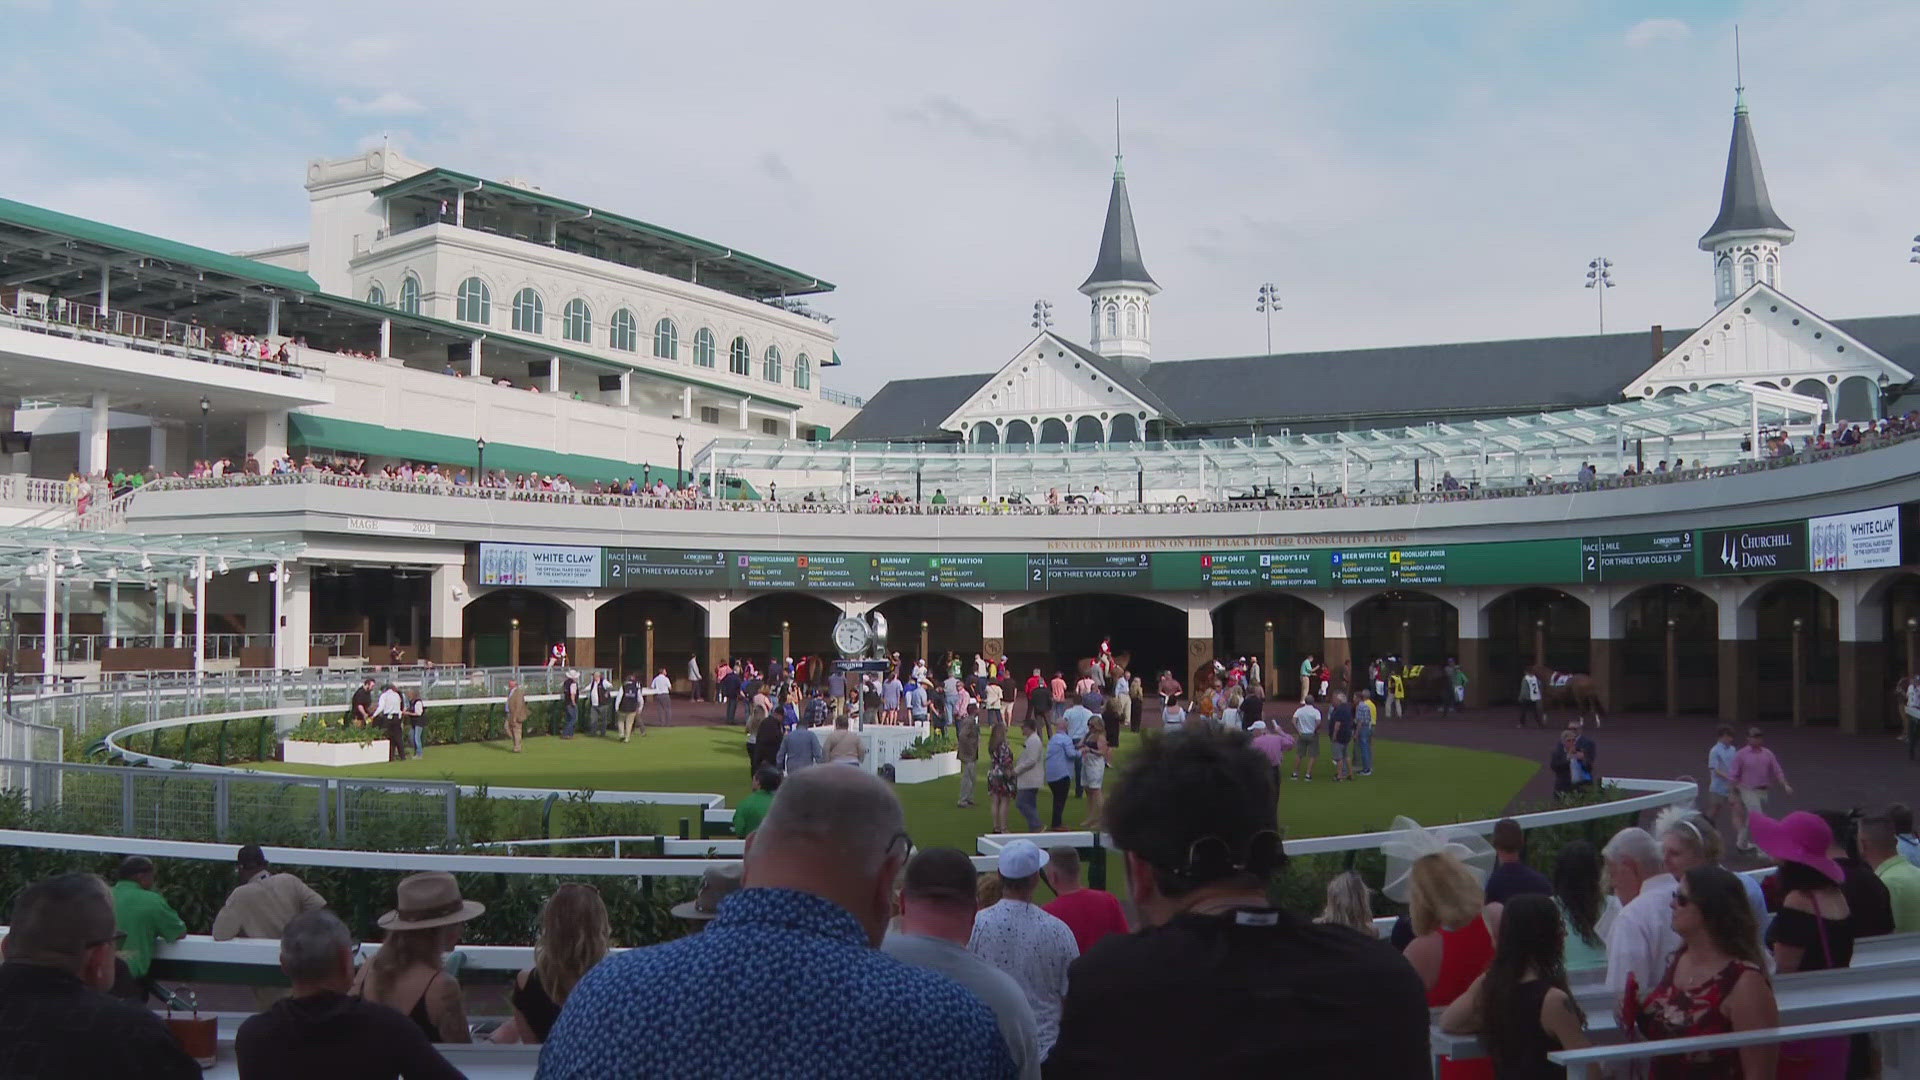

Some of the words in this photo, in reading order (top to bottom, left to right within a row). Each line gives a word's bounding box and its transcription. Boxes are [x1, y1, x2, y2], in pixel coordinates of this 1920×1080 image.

[350, 518, 379, 530] MAGE
[412, 522, 431, 533] 2023
[1850, 521, 1874, 535] WHITE
[1875, 519, 1894, 533] CLAW
[1047, 541, 1103, 549] KENTUCKY
[1107, 540, 1142, 549] DERBY
[1145, 539, 1167, 548] RUN
[1170, 539, 1184, 547] ON
[1188, 538, 1212, 547] THIS
[1215, 537, 1250, 547] TRACK
[1253, 537, 1275, 546] FOR
[1276, 537, 1293, 545] 149
[1297, 535, 1369, 545] CONSECUTIVE
[1373, 534, 1407, 543] YEARS
[1684, 533, 1690, 542] 9
[533, 553, 564, 563] WHITE
[566, 554, 593, 564] CLAW
[718, 552, 724, 560] 9
[1140, 554, 1146, 562] 9
[1588, 556, 1595, 570] 2
[612, 565, 620, 577] 2
[1033, 570, 1041, 581] 2
